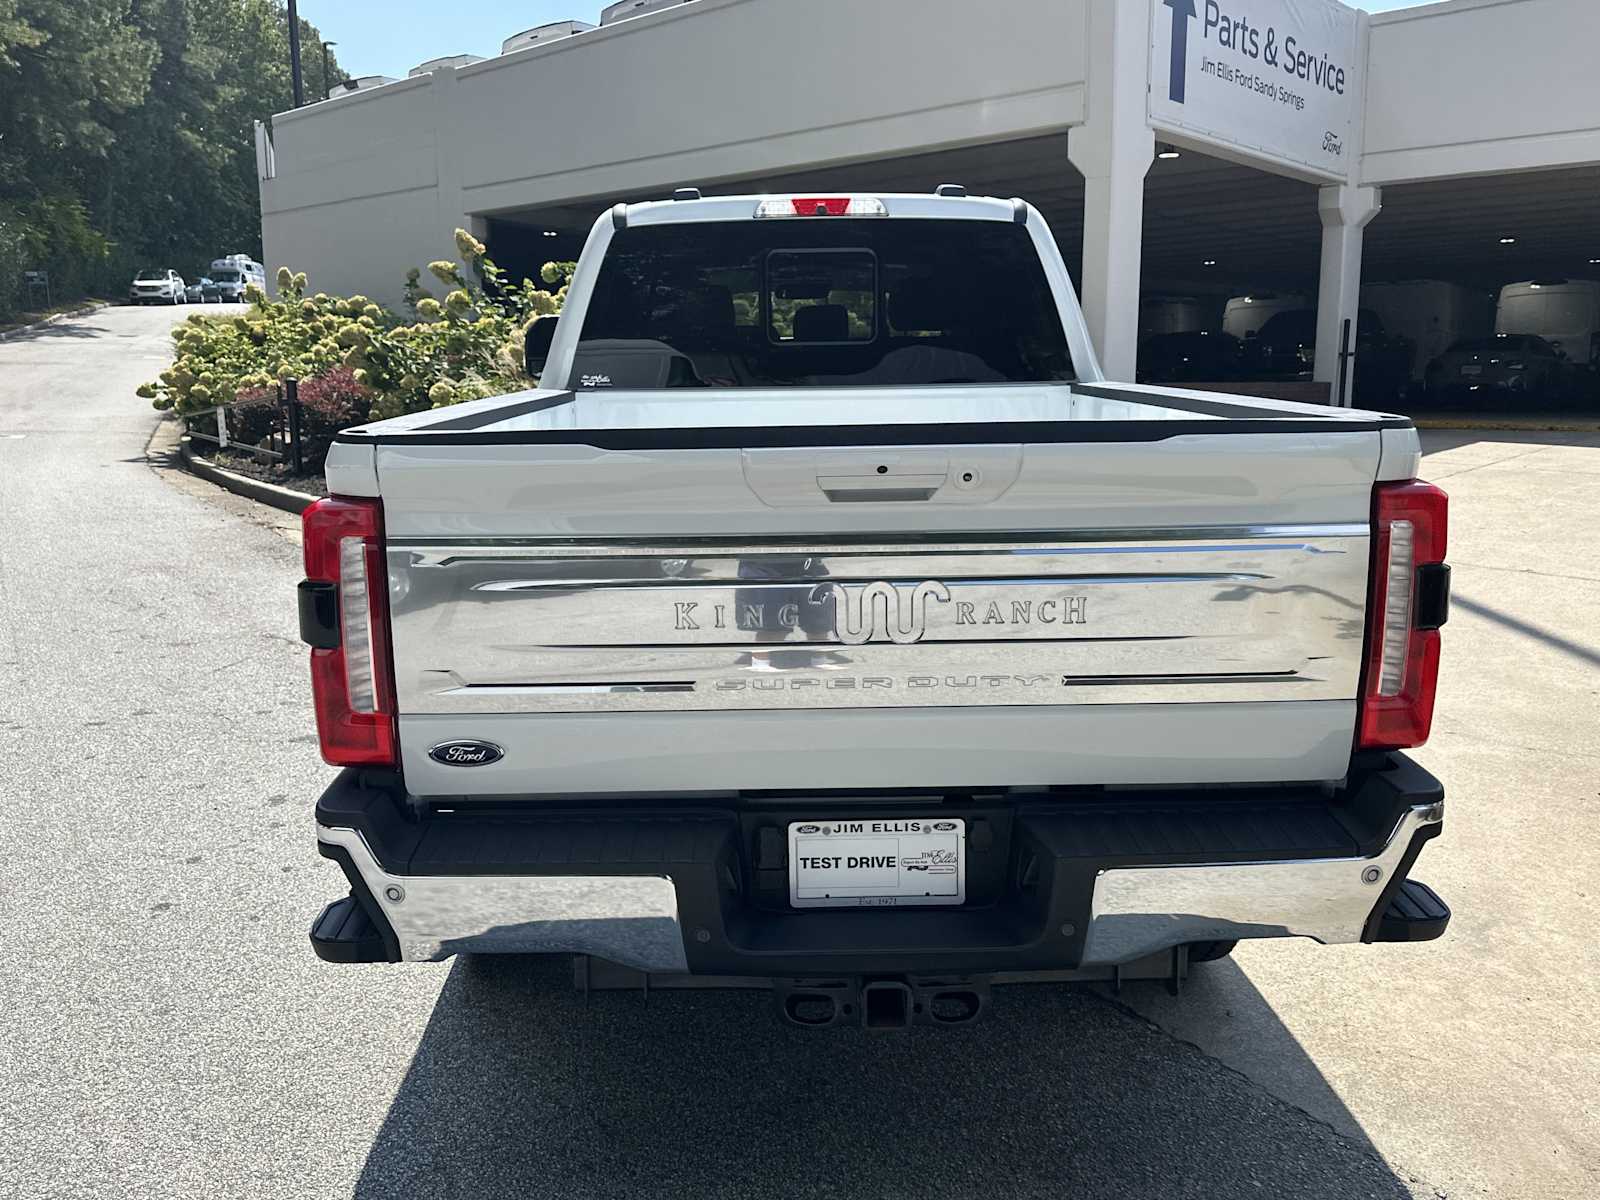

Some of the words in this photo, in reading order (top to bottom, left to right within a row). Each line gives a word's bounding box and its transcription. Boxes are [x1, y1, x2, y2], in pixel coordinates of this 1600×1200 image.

[1204, 0, 1260, 59] Parts
[1264, 27, 1279, 68] &
[1283, 36, 1346, 95] Service
[1200, 56, 1216, 76] Jim
[1216, 62, 1234, 82] Ellis
[1234, 68, 1253, 90] Ford
[1254, 76, 1278, 102] Sandy
[1278, 86, 1305, 111] Springs
[1320, 131, 1343, 156] Ford
[673, 601, 802, 630] KING
[954, 596, 1089, 626] RANCH
[715, 677, 893, 691] SUPER
[907, 674, 1051, 688] DUTY
[445, 745, 487, 762] Ford
[833, 823, 864, 834] JIM
[871, 822, 921, 833] ELLIS
[799, 856, 843, 869] TEST
[847, 856, 897, 869] DRIVE
